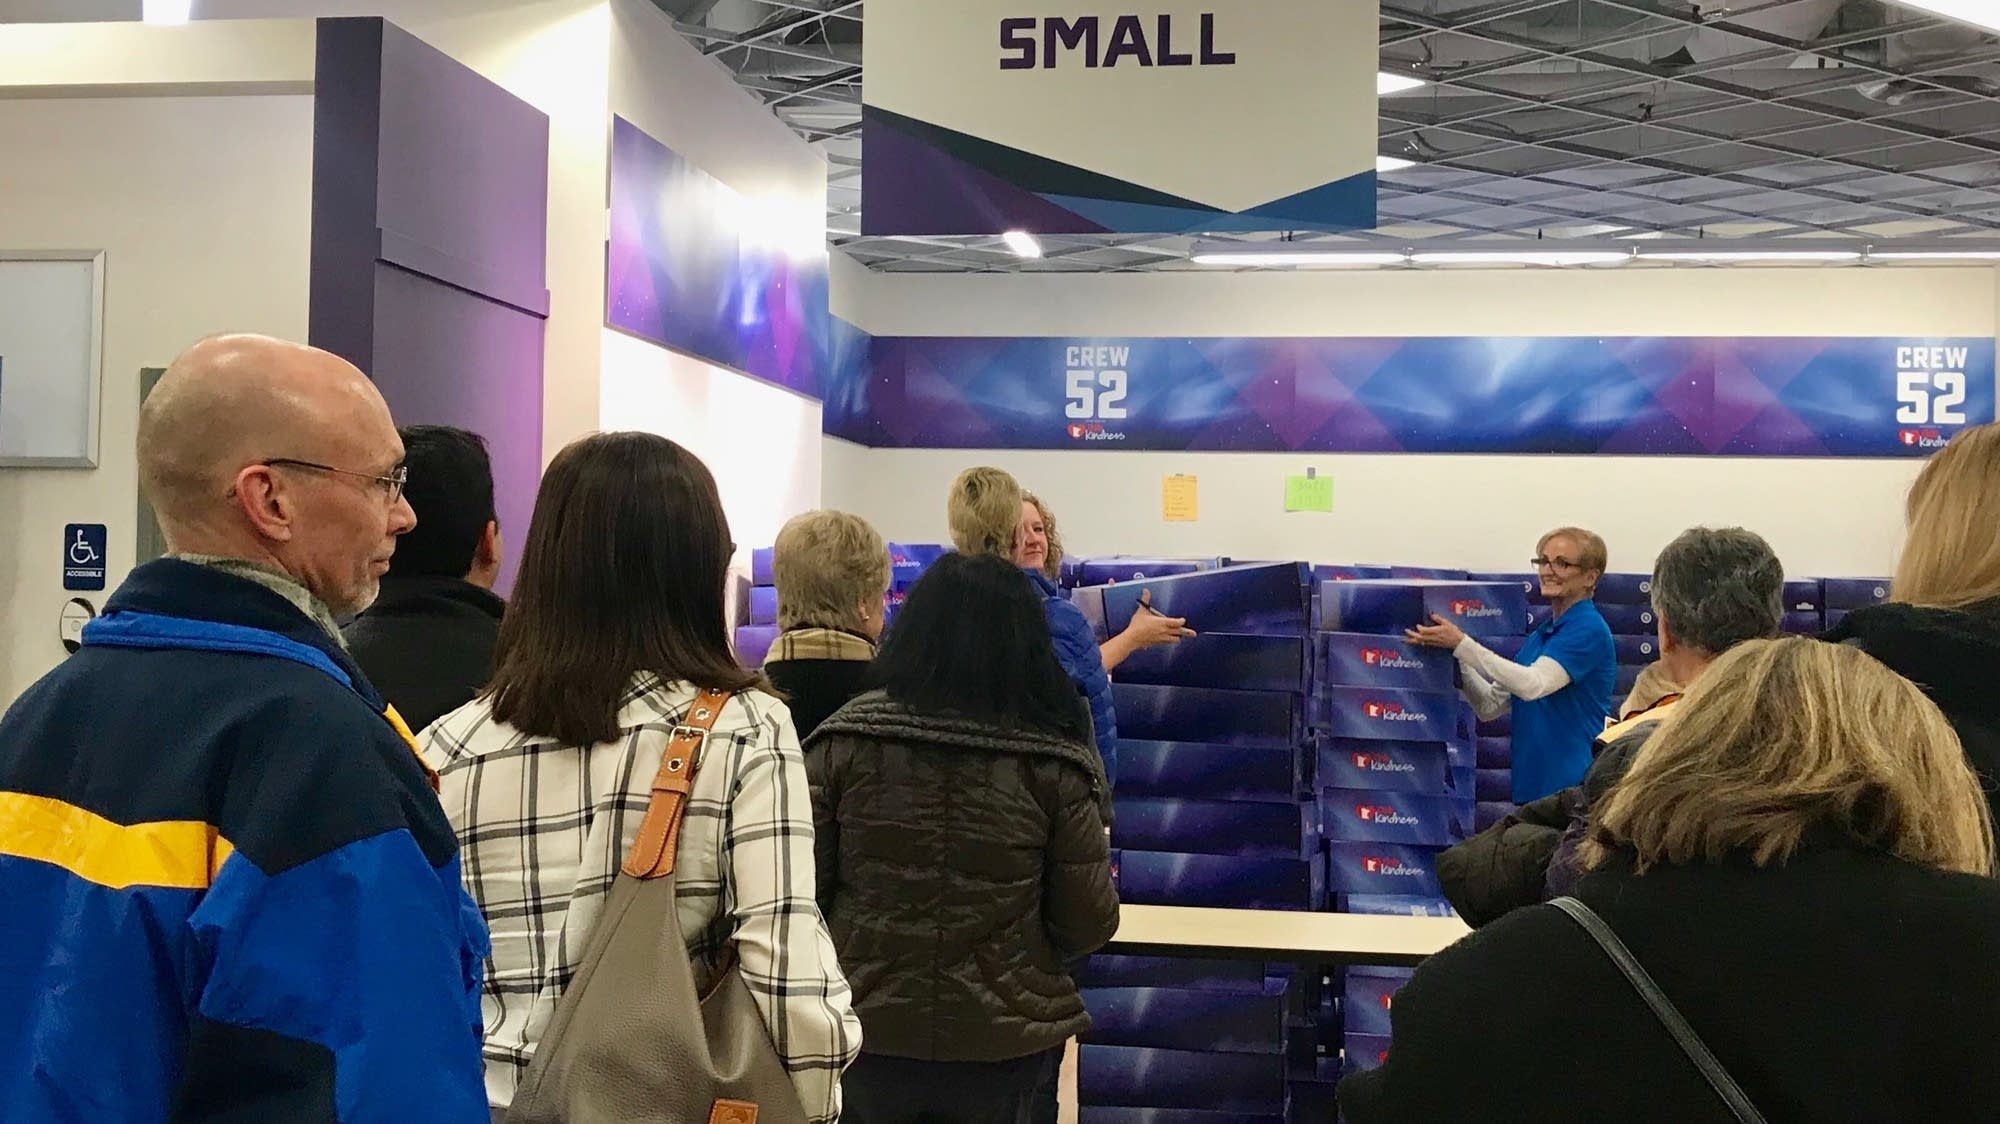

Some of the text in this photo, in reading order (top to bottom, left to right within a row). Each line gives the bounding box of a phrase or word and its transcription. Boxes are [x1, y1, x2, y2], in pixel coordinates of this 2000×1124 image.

[1000, 13, 1236, 70] SMALL
[1066, 346, 1129, 367] CREW
[1897, 346, 1968, 369] CREW
[1065, 370, 1127, 419] 52
[1896, 371, 1966, 424] 52
